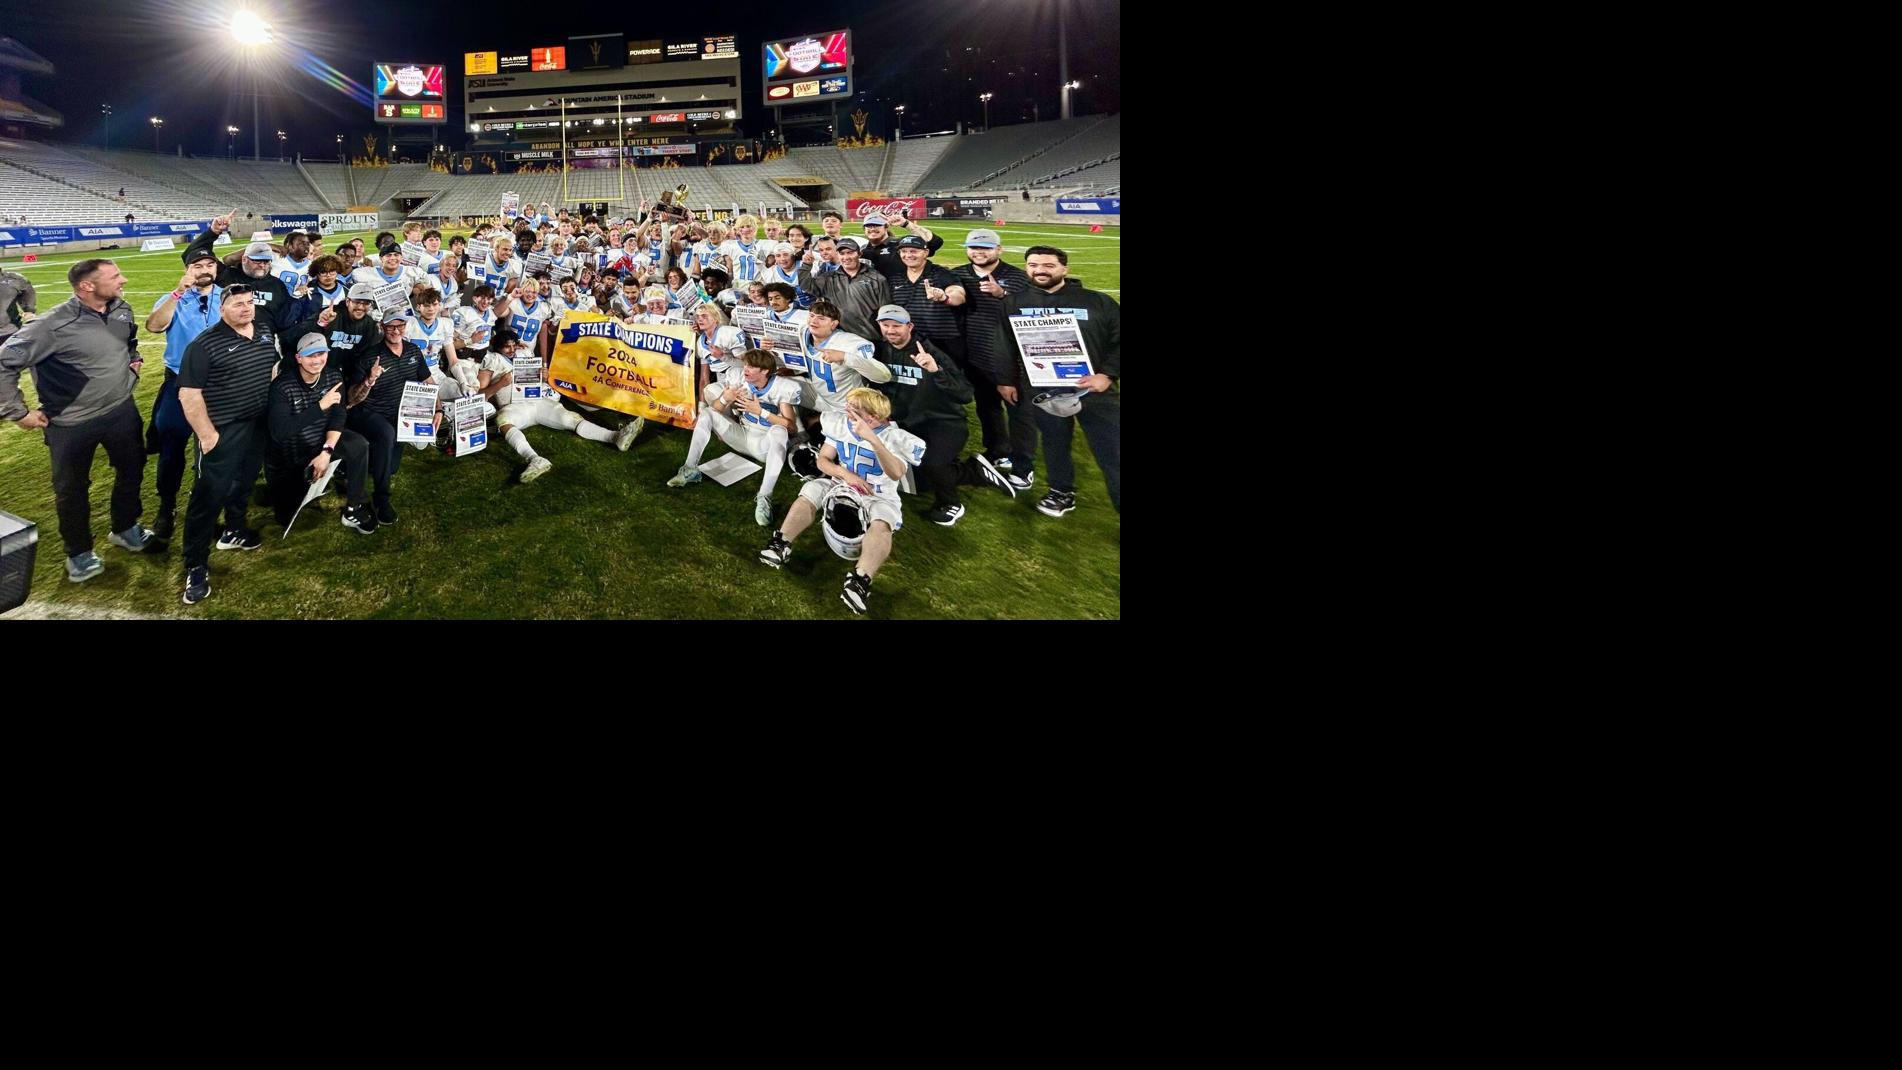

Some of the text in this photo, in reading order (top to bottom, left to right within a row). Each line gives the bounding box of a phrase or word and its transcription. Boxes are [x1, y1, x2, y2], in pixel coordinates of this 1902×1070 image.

[630, 48, 660, 56] POWERADE
[271, 219, 317, 229] olkswagen
[321, 215, 376, 226] SPROUTS
[739, 255, 754, 281] 11
[374, 288, 385, 296] STATE
[485, 274, 507, 296] 51
[511, 314, 540, 342] 58
[1014, 318, 1072, 328] STATE CHAMPS!
[579, 324, 673, 353] STATE CMPIONS
[608, 348, 637, 367] 2024
[586, 356, 657, 389] FOOTBALL
[592, 376, 603, 384] 4A
[559, 382, 573, 390] AIA
[836, 440, 884, 481] 42
